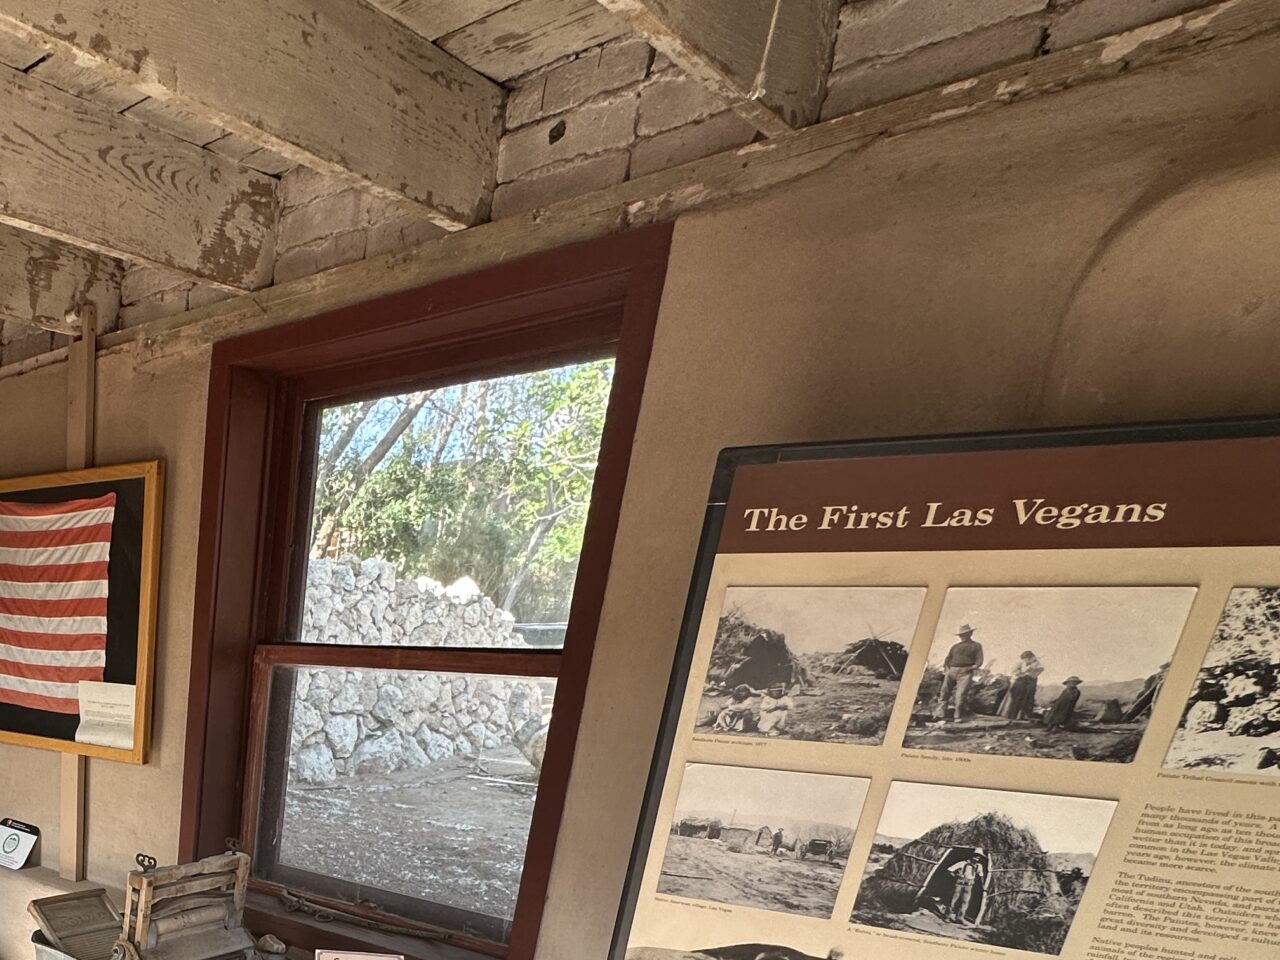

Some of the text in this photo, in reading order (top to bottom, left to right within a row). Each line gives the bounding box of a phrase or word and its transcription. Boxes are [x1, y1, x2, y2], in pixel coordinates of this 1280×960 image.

[743, 499, 1167, 532] The First Las Vegans
